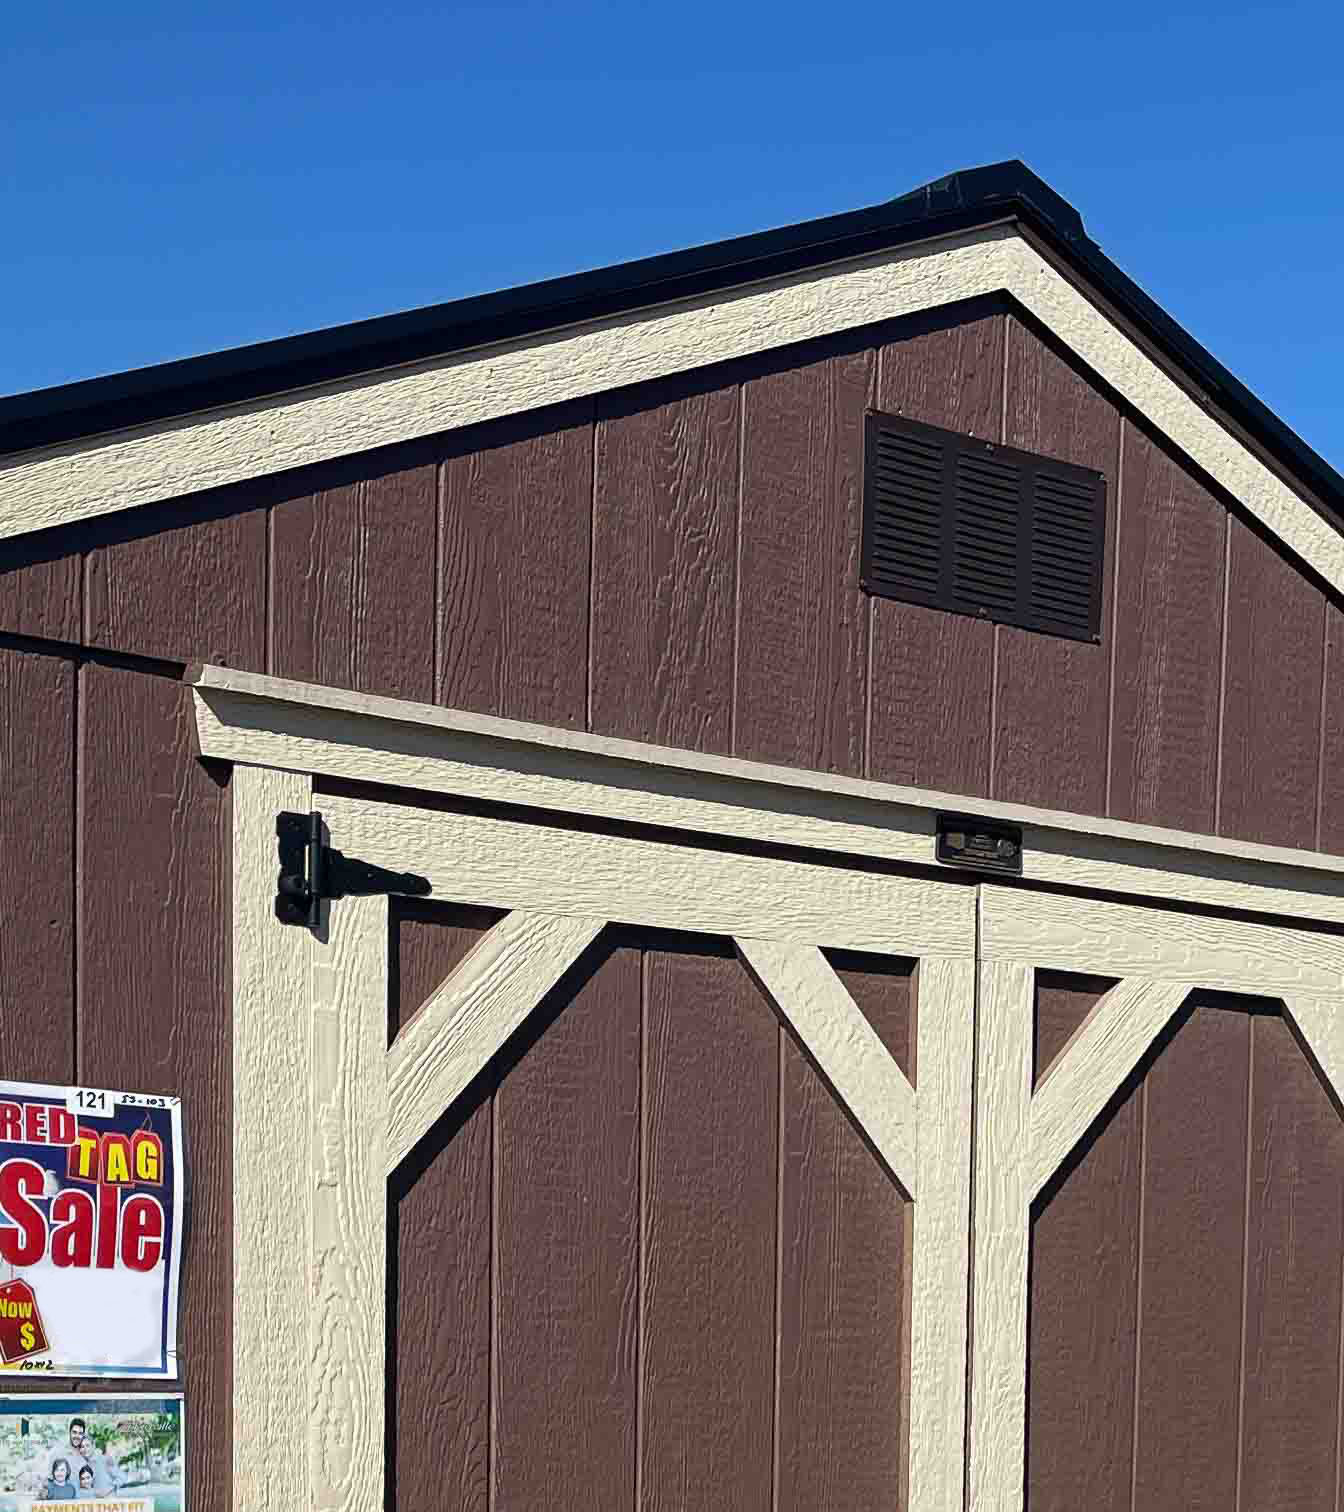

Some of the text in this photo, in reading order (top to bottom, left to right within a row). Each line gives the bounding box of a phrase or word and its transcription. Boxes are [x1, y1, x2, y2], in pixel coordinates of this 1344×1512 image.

[75, 1090, 106, 1110] 121
[78, 1136, 159, 1182] TAG
[20, 1321, 36, 1352] $
[96, 1502, 124, 1512] THAT
